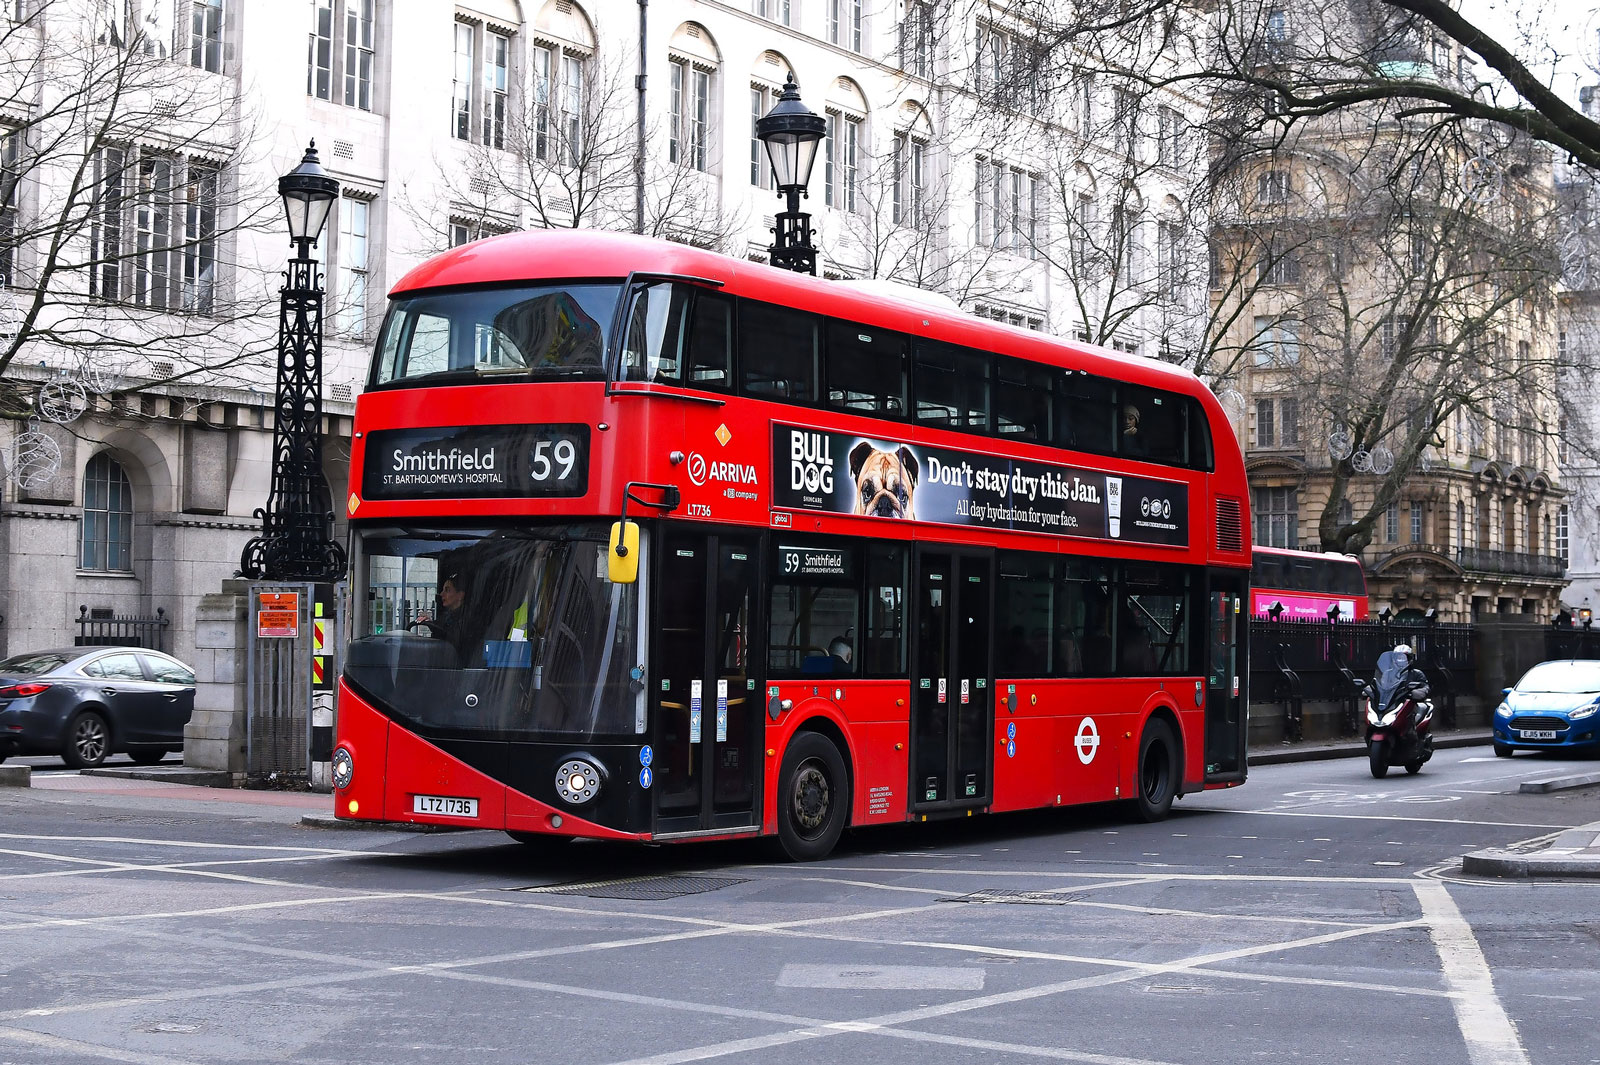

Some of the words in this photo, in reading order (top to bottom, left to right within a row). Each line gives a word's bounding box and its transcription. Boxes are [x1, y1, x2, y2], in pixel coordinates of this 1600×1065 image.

[392, 447, 495, 471] Smithfield
[791, 429, 834, 466] BULL
[531, 439, 576, 481] 59
[383, 474, 394, 484] ST.
[395, 473, 463, 484] BARTHOLOMEW'S
[465, 473, 503, 483] HOSPITAL
[708, 460, 758, 485] ARRIVA
[791, 460, 834, 494] DOG
[927, 456, 974, 489] Don't
[975, 467, 1010, 498] stay
[1011, 467, 1039, 501] dry
[1040, 471, 1069, 500] this
[1070, 476, 1101, 504] Jan.
[735, 491, 758, 501] company
[803, 495, 823, 504] SKINCARE
[687, 503, 711, 517] LT736
[955, 499, 969, 516] All
[970, 500, 986, 521] day
[986, 502, 1028, 522] hydration
[1028, 506, 1040, 523] for
[1041, 512, 1060, 527] your
[1060, 510, 1079, 527] face.
[784, 553, 800, 573] 59
[804, 553, 842, 567] Smithfield
